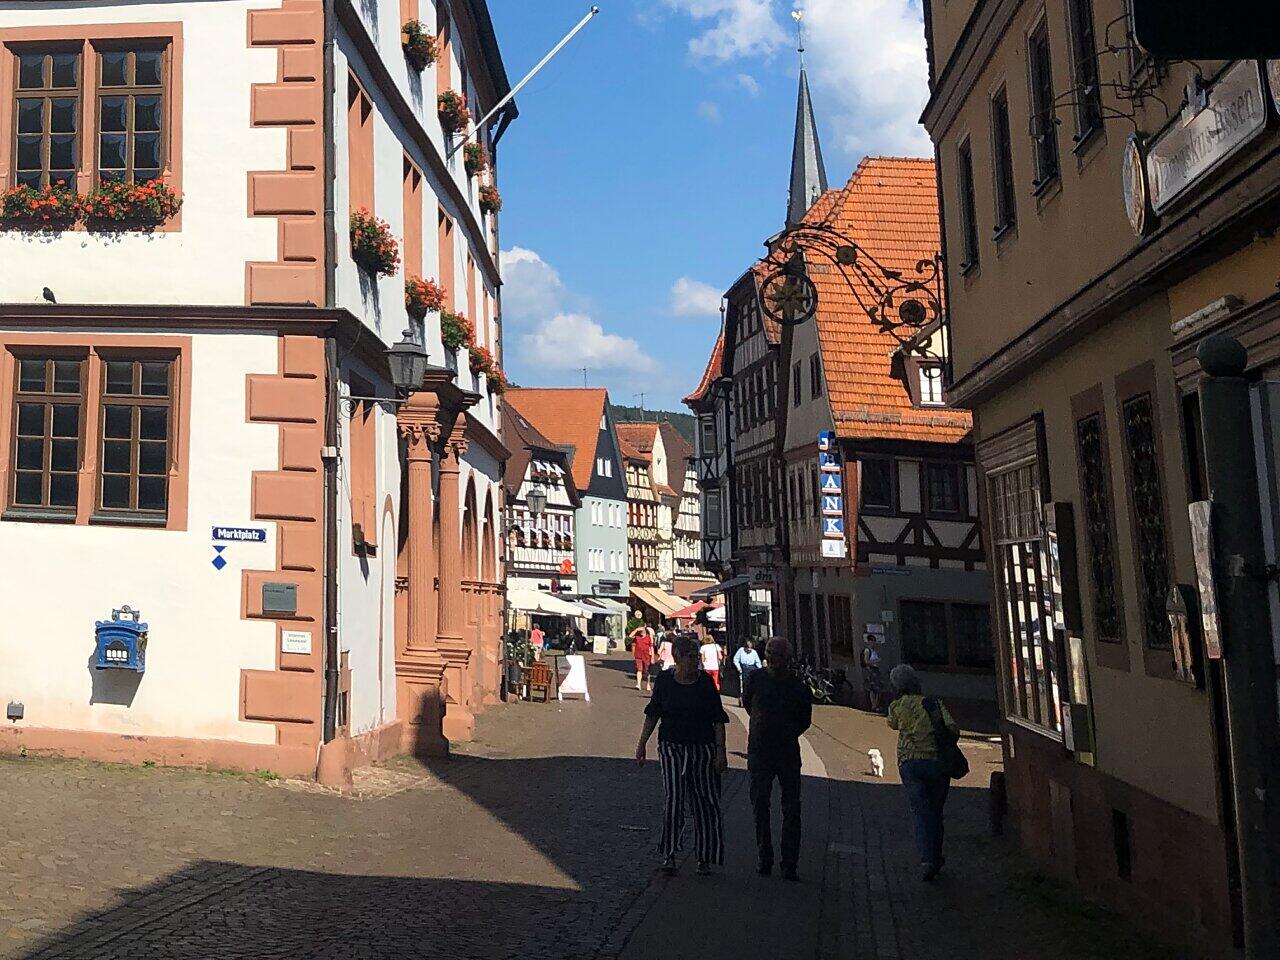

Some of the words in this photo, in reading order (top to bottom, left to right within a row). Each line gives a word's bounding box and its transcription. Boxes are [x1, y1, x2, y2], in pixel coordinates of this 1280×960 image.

[823, 453, 841, 532] BANK
[218, 529, 260, 540] Marktplatz
[755, 571, 772, 580] dm
